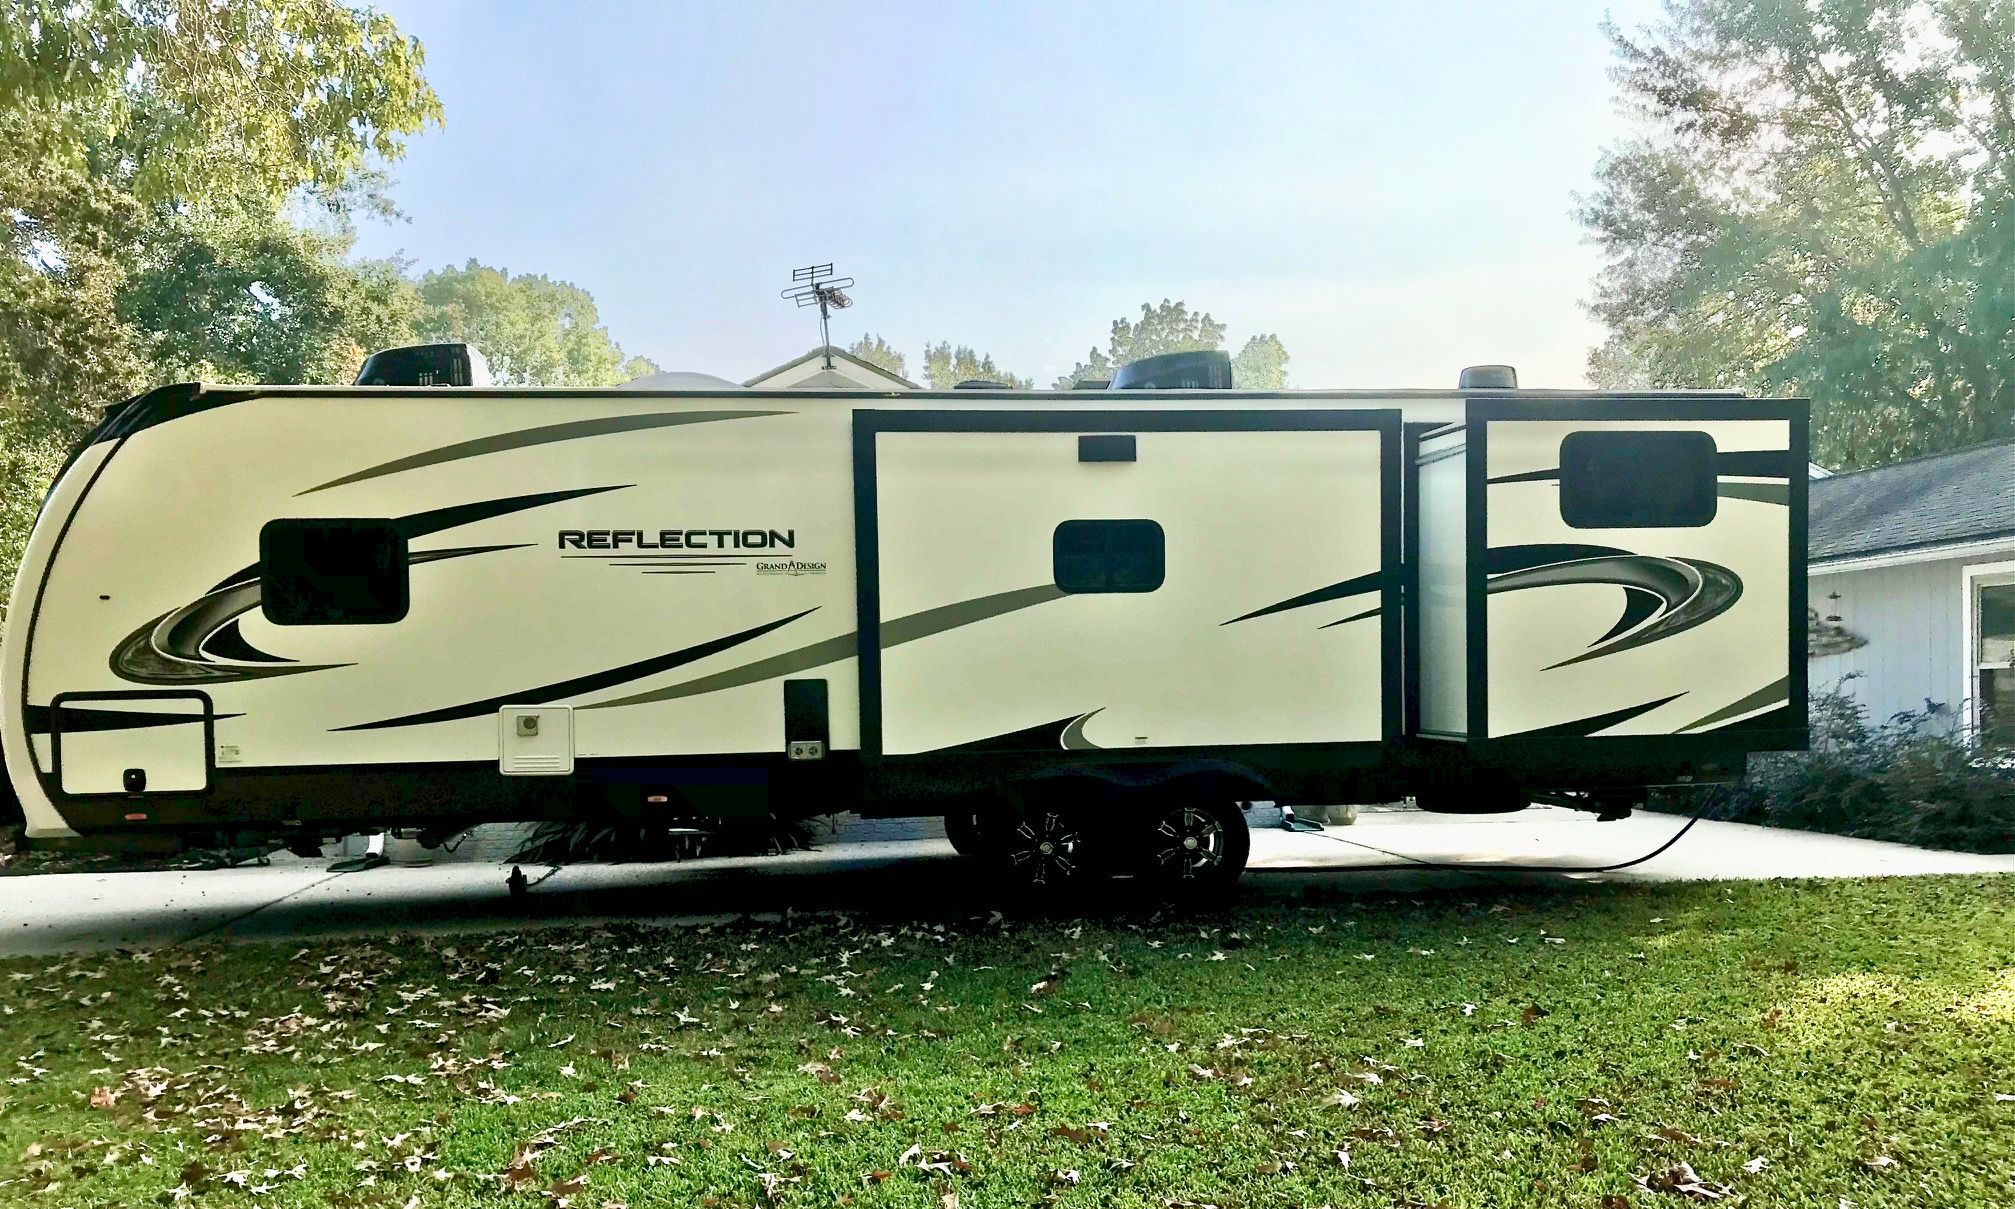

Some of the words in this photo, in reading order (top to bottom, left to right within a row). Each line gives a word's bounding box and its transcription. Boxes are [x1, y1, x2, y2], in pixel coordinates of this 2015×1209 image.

[558, 529, 795, 549] REFLECTION
[756, 562, 788, 570] GRAND
[796, 562, 827, 570] DESIGN
